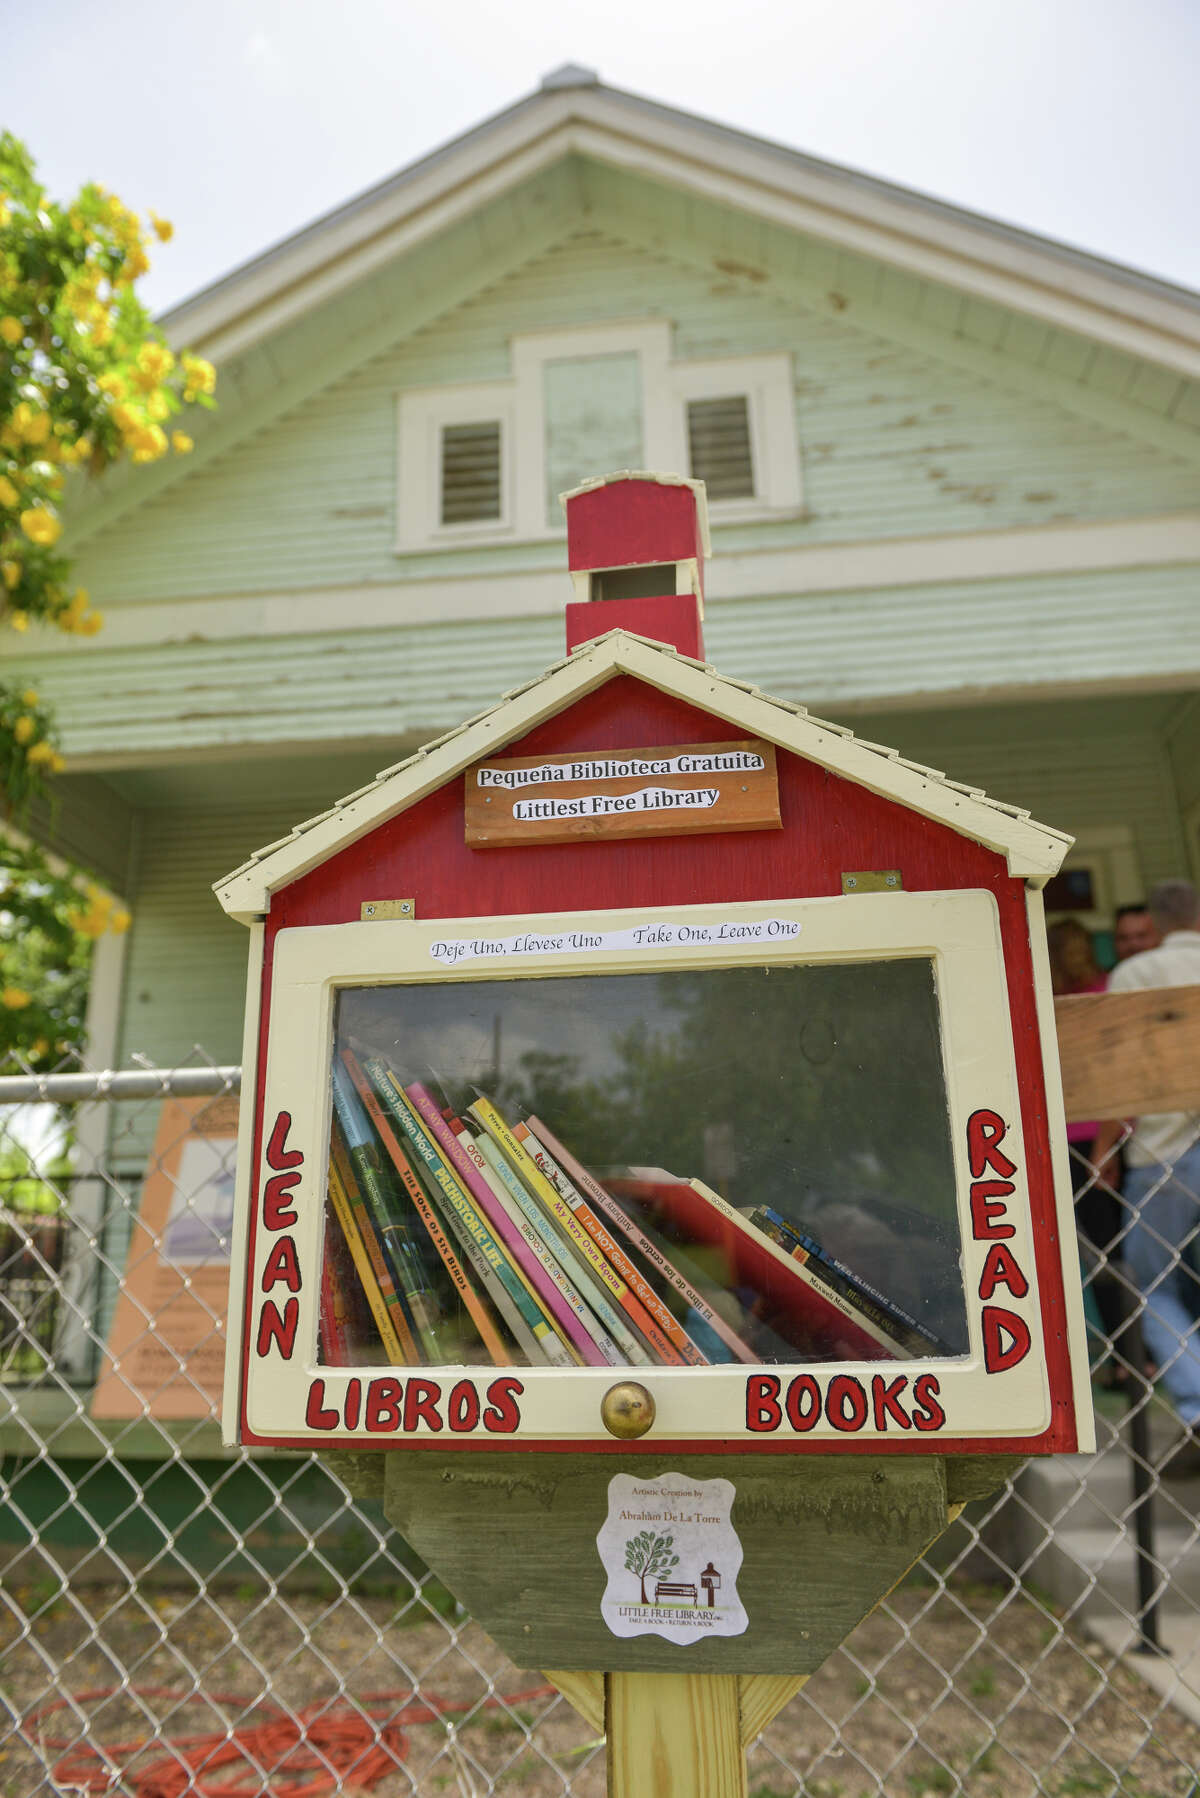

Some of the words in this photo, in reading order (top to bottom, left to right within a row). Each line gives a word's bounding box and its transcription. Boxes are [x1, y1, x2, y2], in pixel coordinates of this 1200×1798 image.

[480, 763, 564, 788] Pequeña
[570, 758, 671, 781] Biblioteca
[677, 752, 762, 772] Gratuita
[515, 798, 586, 819] Littlest
[592, 796, 636, 813] Free
[643, 788, 719, 808] Library
[633, 925, 672, 944] Take
[678, 926, 712, 943] One,
[716, 924, 762, 940] Leave
[767, 920, 799, 936] One
[432, 943, 465, 964] Deje
[470, 941, 506, 955] Uno,
[568, 934, 602, 948] Uno
[370, 1065, 399, 1103] Nature's
[392, 1102, 417, 1133] Hidden
[412, 1134, 434, 1160] World
[428, 1111, 442, 1128] MY
[440, 1129, 474, 1174] WINDOW
[466, 1144, 485, 1167] ROJO
[580, 1175, 606, 1202] Browne
[432, 1167, 488, 1242] PREHISTORIC
[481, 1242, 503, 1268] LIFE
[604, 1201, 634, 1232] Anthony
[256, 1110, 304, 1360] LEAN
[413, 1191, 431, 1219] SONG
[446, 1257, 467, 1289] BIRDS
[439, 1197, 454, 1215] Spot
[468, 1243, 478, 1256] the
[475, 1257, 490, 1276] Park
[521, 1223, 543, 1252] COLORES
[553, 1201, 567, 1217] My
[564, 1218, 583, 1239] Very
[581, 1239, 600, 1261] Own
[598, 1261, 621, 1289] Room
[966, 1109, 1031, 1374] READ
[594, 1230, 613, 1252] NOT
[609, 1251, 630, 1276] Going
[637, 1238, 663, 1265] cerdos
[661, 1264, 675, 1279] los
[674, 1278, 686, 1290] de
[684, 1289, 703, 1309] libro
[702, 1308, 713, 1319] El
[889, 1303, 916, 1325] SUPER
[305, 1376, 525, 1433] LIBROS
[745, 1373, 946, 1433] BOOKS
[631, 1487, 658, 1496] Artistic
[660, 1488, 692, 1498] Creation
[694, 1489, 704, 1499] by
[619, 1510, 661, 1521] Abraham
[663, 1512, 677, 1522] De
[680, 1513, 692, 1523] La
[694, 1513, 721, 1524] Torre
[619, 1607, 649, 1617] LITTLE
[651, 1608, 674, 1618] FREE
